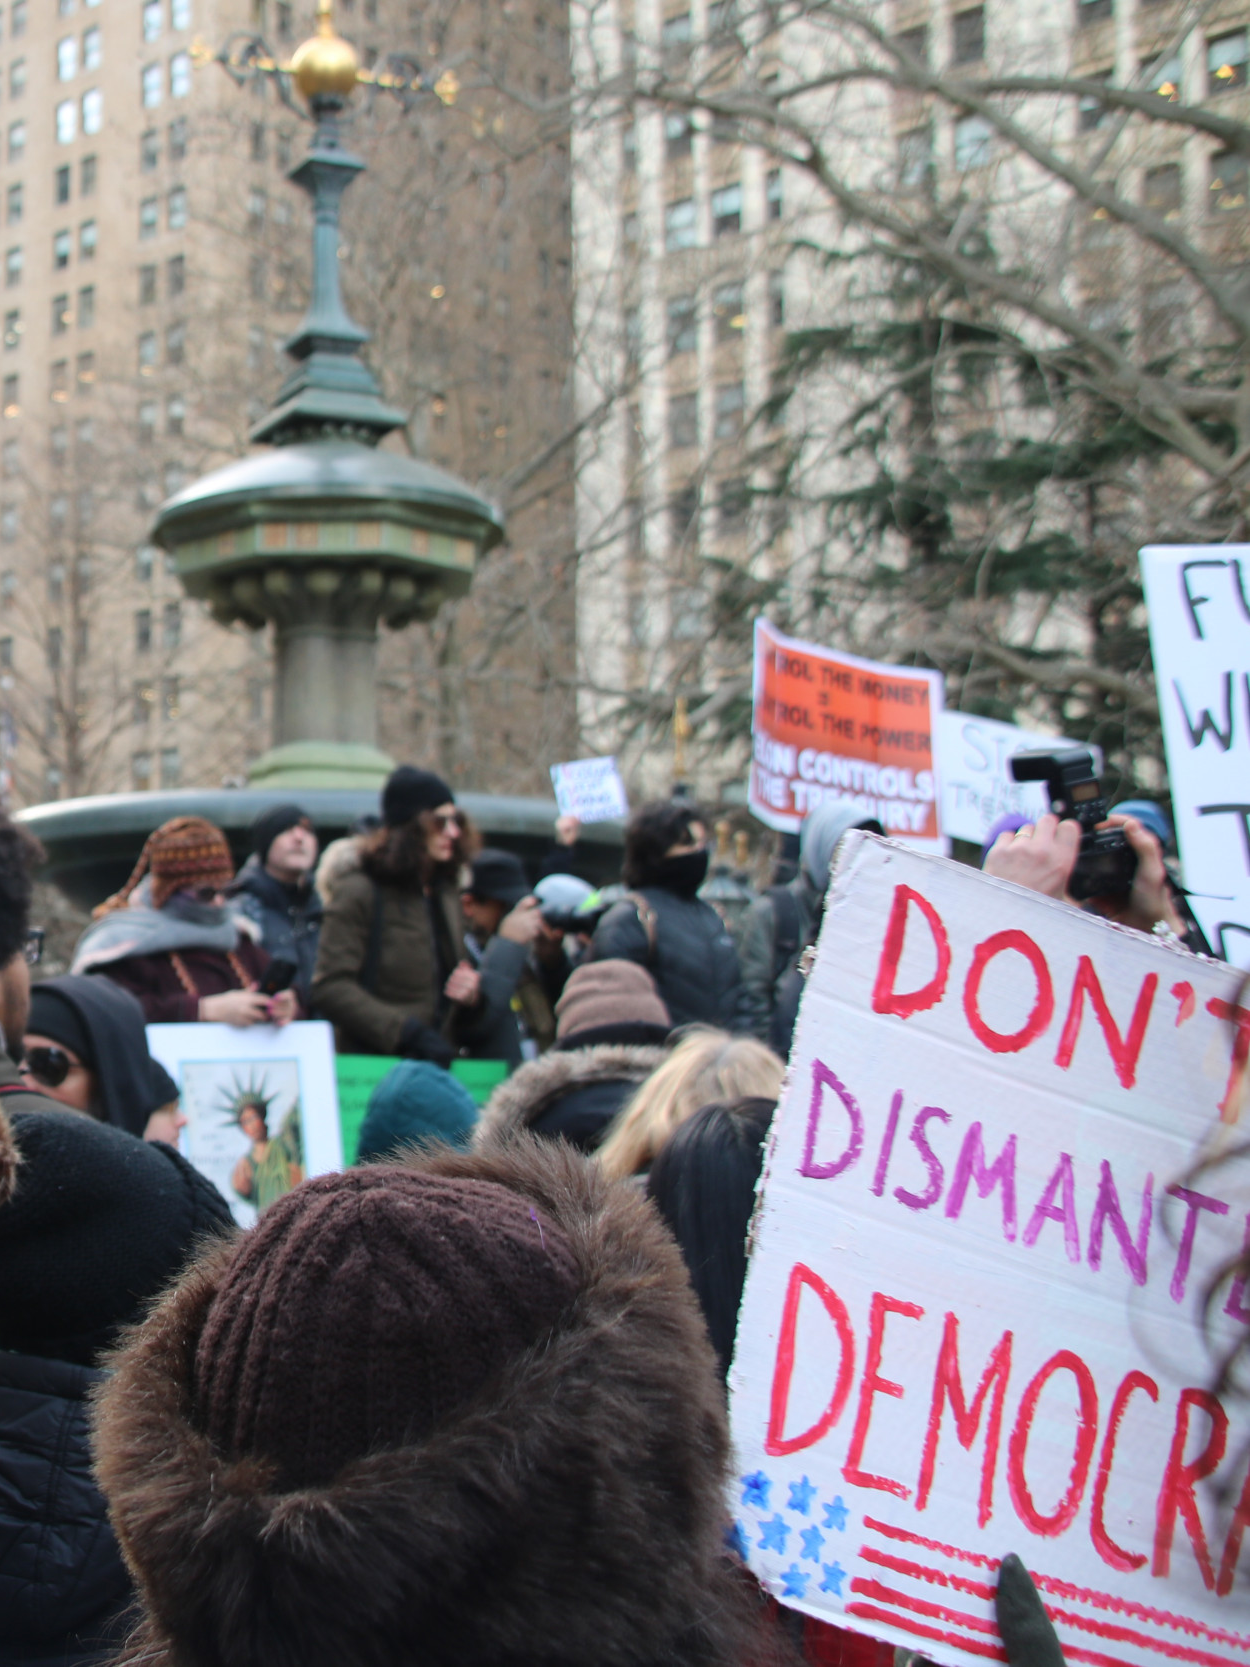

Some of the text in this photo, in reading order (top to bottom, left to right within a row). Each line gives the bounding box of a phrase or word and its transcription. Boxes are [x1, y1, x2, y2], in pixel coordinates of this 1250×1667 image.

[819, 666, 854, 693] THE
[858, 677, 929, 706] MONEY
[820, 713, 855, 740] THE
[860, 724, 932, 753] POWER
[756, 766, 928, 833] THE TRURY
[797, 747, 936, 802] CONTROLS
[871, 883, 1250, 1125] DON'T
